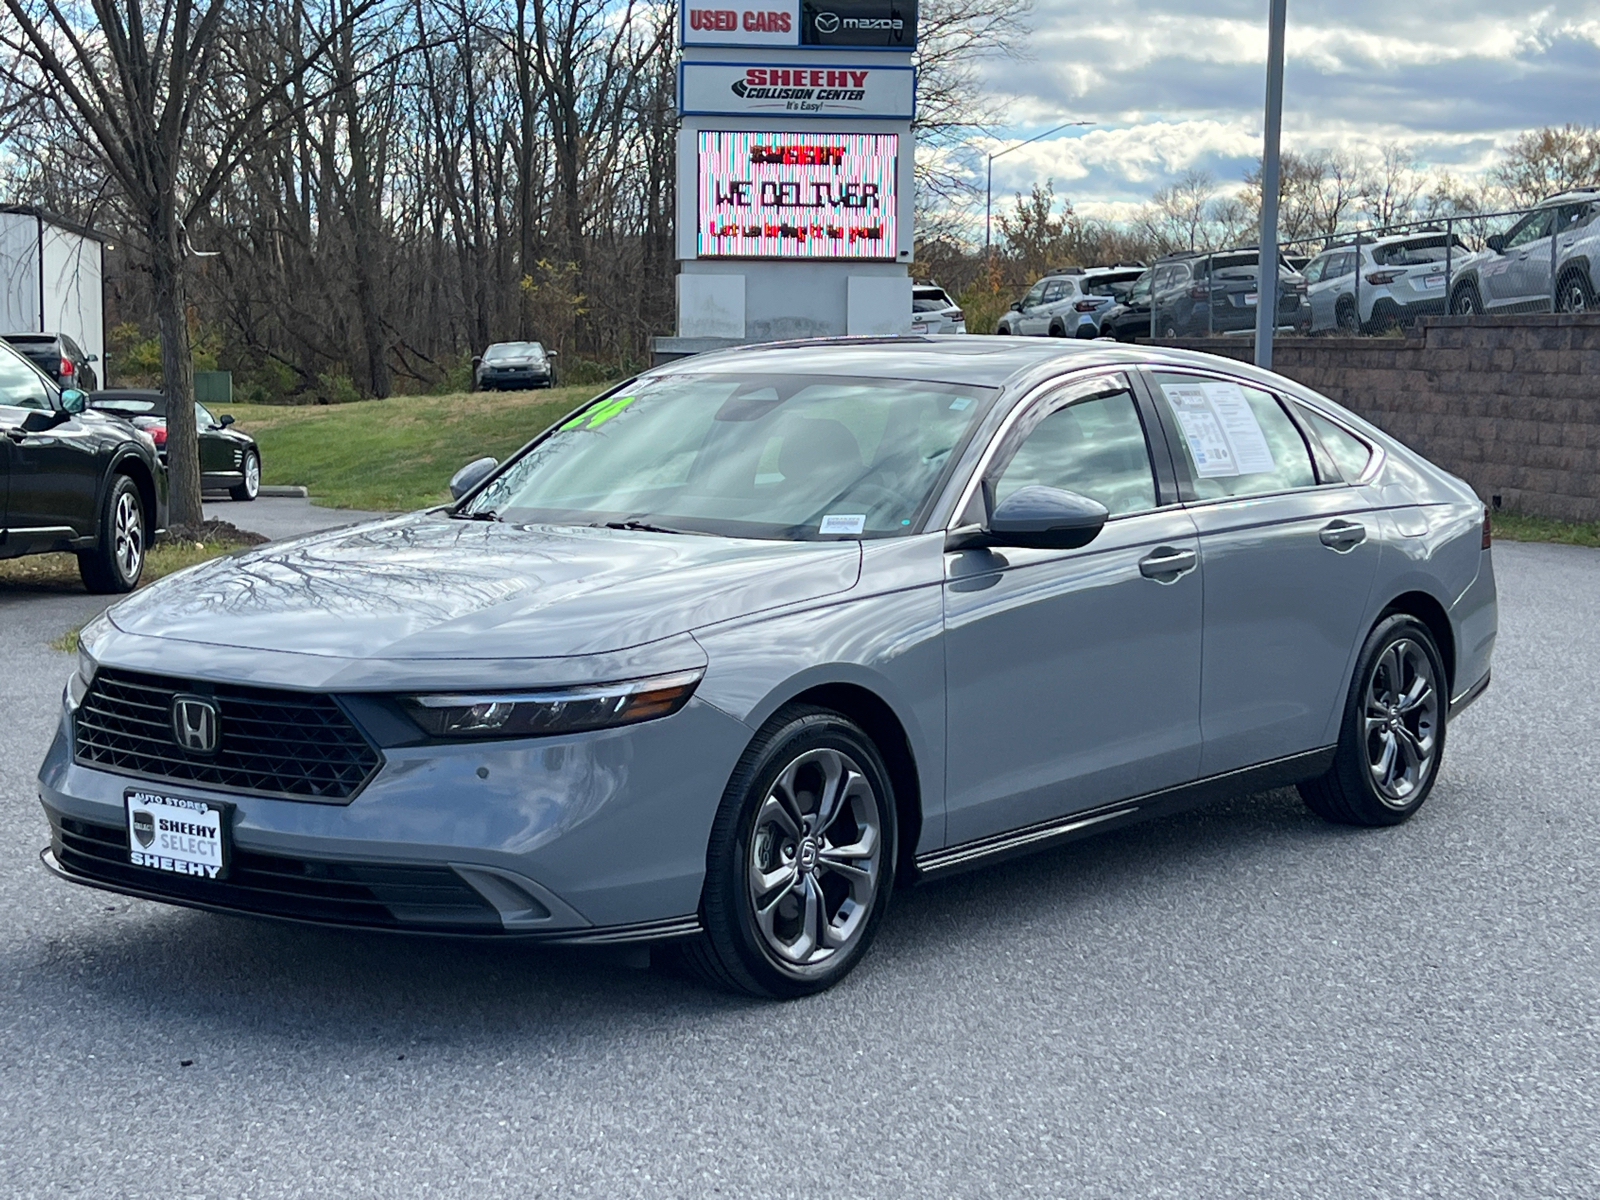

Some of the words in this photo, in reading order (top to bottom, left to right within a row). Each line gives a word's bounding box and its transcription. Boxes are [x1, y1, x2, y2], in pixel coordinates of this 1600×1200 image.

[690, 9, 737, 31] USED
[743, 11, 792, 33] CARS
[842, 17, 903, 30] mazda
[746, 69, 869, 88] SHEEHY
[746, 88, 814, 100] COLLISION
[816, 89, 866, 101] CENTER
[786, 101, 799, 110] It's
[800, 101, 823, 112] Easy!
[716, 181, 753, 207] WE
[761, 181, 880, 208] DELIVER
[134, 792, 163, 804] AUTO
[165, 797, 209, 811] STORES
[158, 818, 217, 839] SHEEHY
[160, 833, 218, 857] SELECT
[130, 851, 221, 879] SHEEHY
